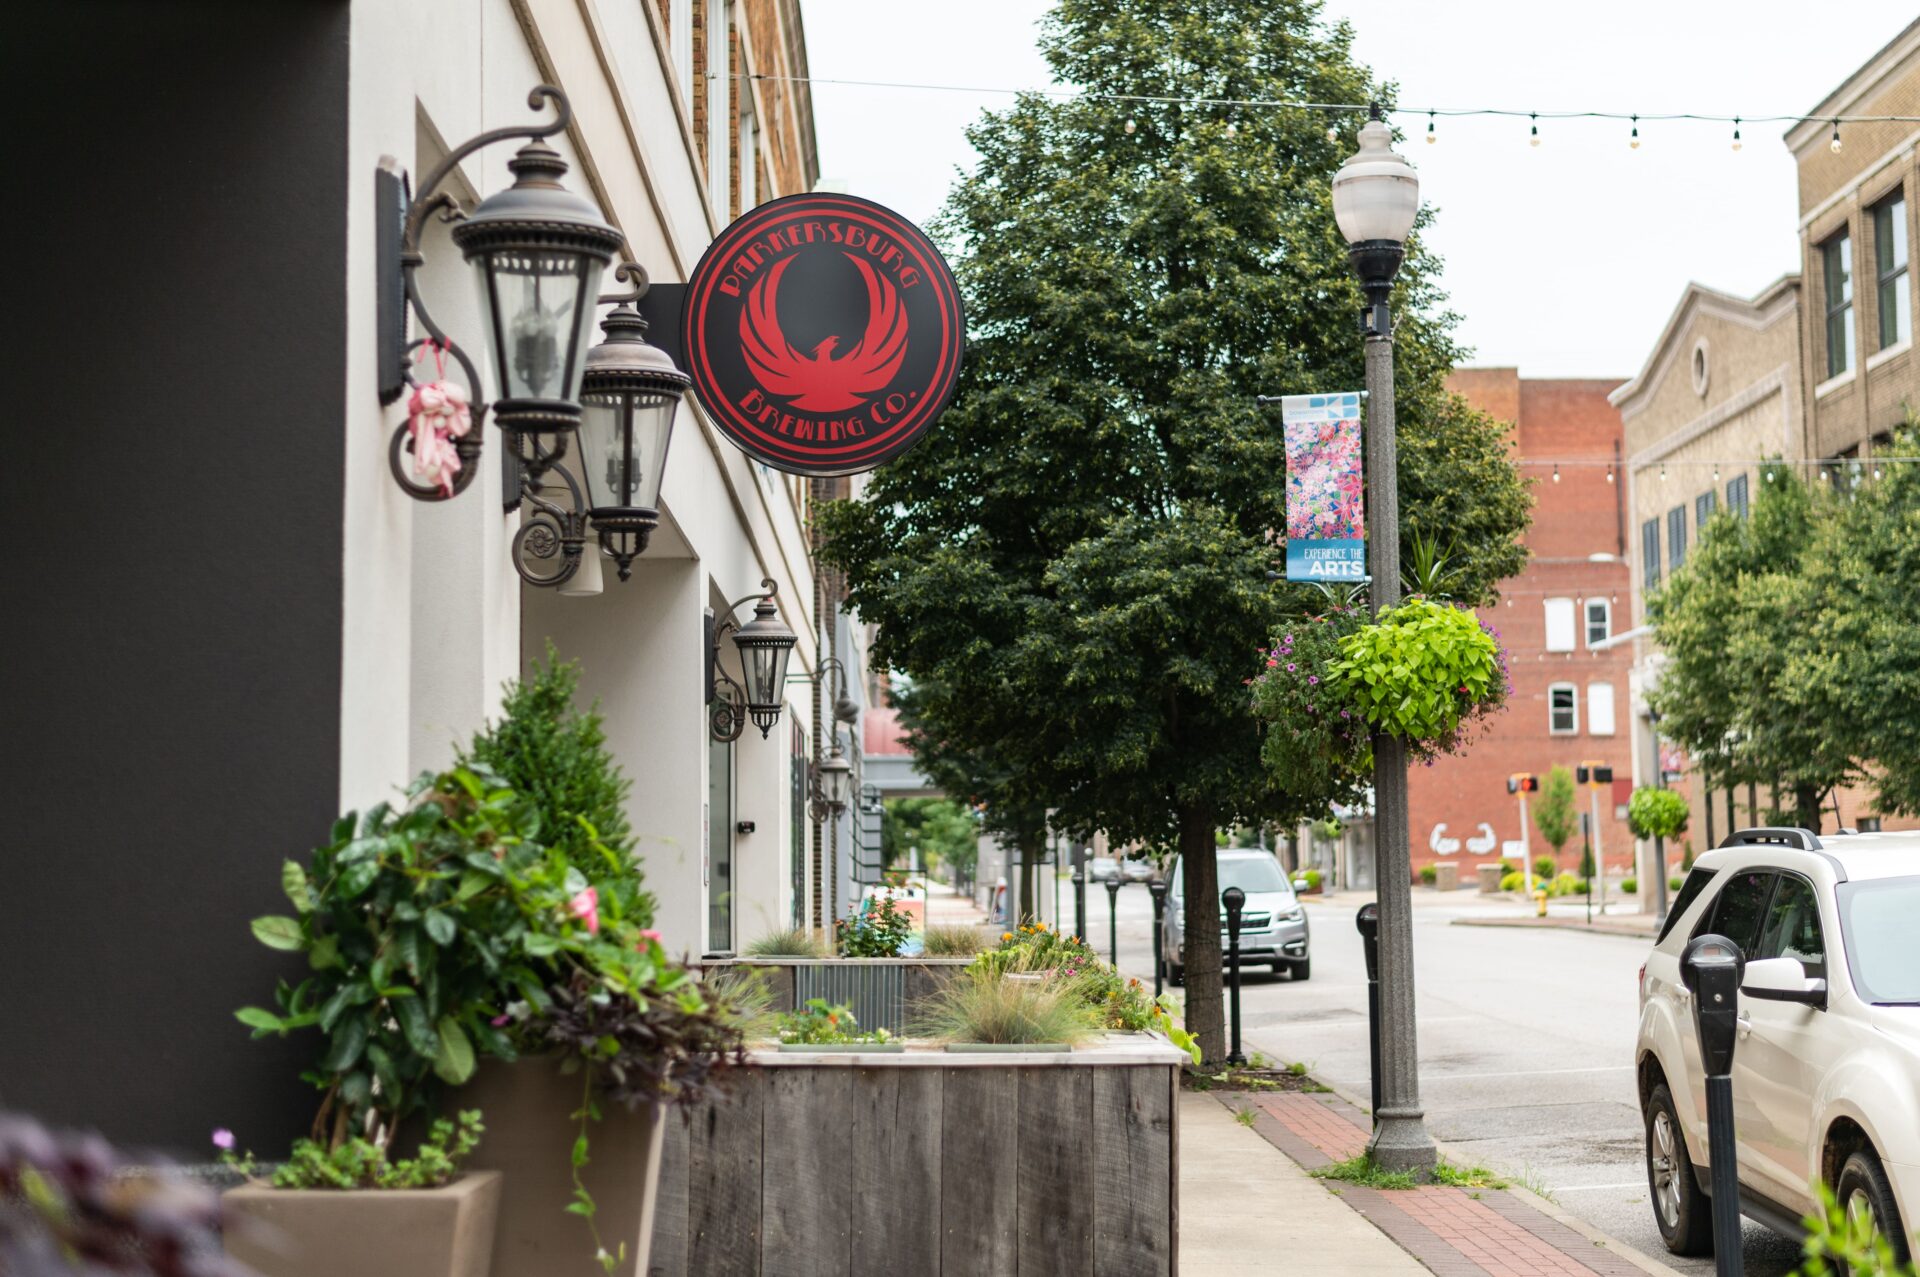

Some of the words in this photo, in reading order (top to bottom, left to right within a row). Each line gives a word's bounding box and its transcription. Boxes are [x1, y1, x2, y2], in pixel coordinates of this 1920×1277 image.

[719, 222, 921, 298] PARKERSBURG
[739, 388, 867, 441] BREWING
[870, 390, 918, 425] CO.
[1304, 548, 1346, 560] EXPERIENCE
[1350, 548, 1363, 560] THE
[1309, 560, 1363, 576] ARTS
